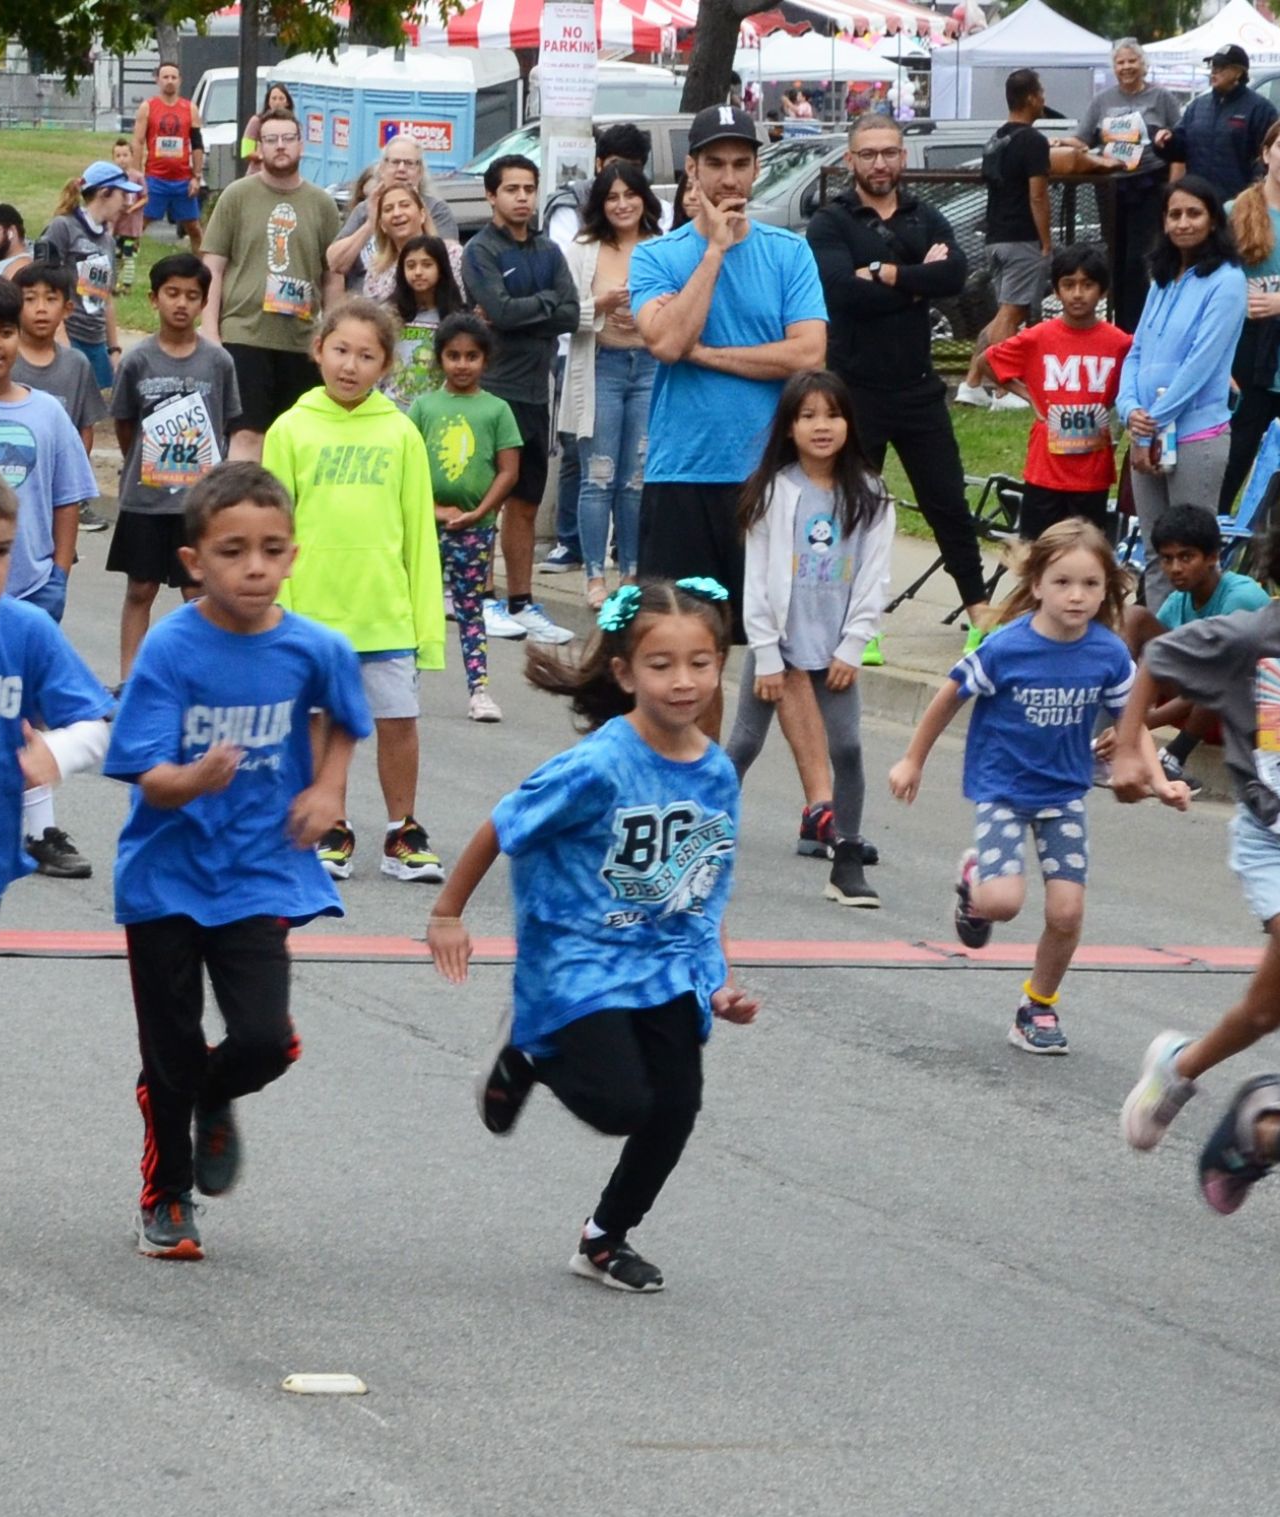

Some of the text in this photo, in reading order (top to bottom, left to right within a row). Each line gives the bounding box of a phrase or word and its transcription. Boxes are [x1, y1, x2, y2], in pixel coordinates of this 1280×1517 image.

[563, 26, 582, 39] NO
[544, 40, 595, 53] PARKING
[718, 106, 735, 125] N
[398, 123, 446, 140] Honey
[278, 280, 304, 299] 754
[1043, 354, 1116, 393] MV
[155, 405, 206, 437] ROCKS
[1060, 411, 1096, 430] 661
[159, 443, 199, 464] 782
[313, 445, 394, 486] NIKE
[614, 809, 694, 872] BG
